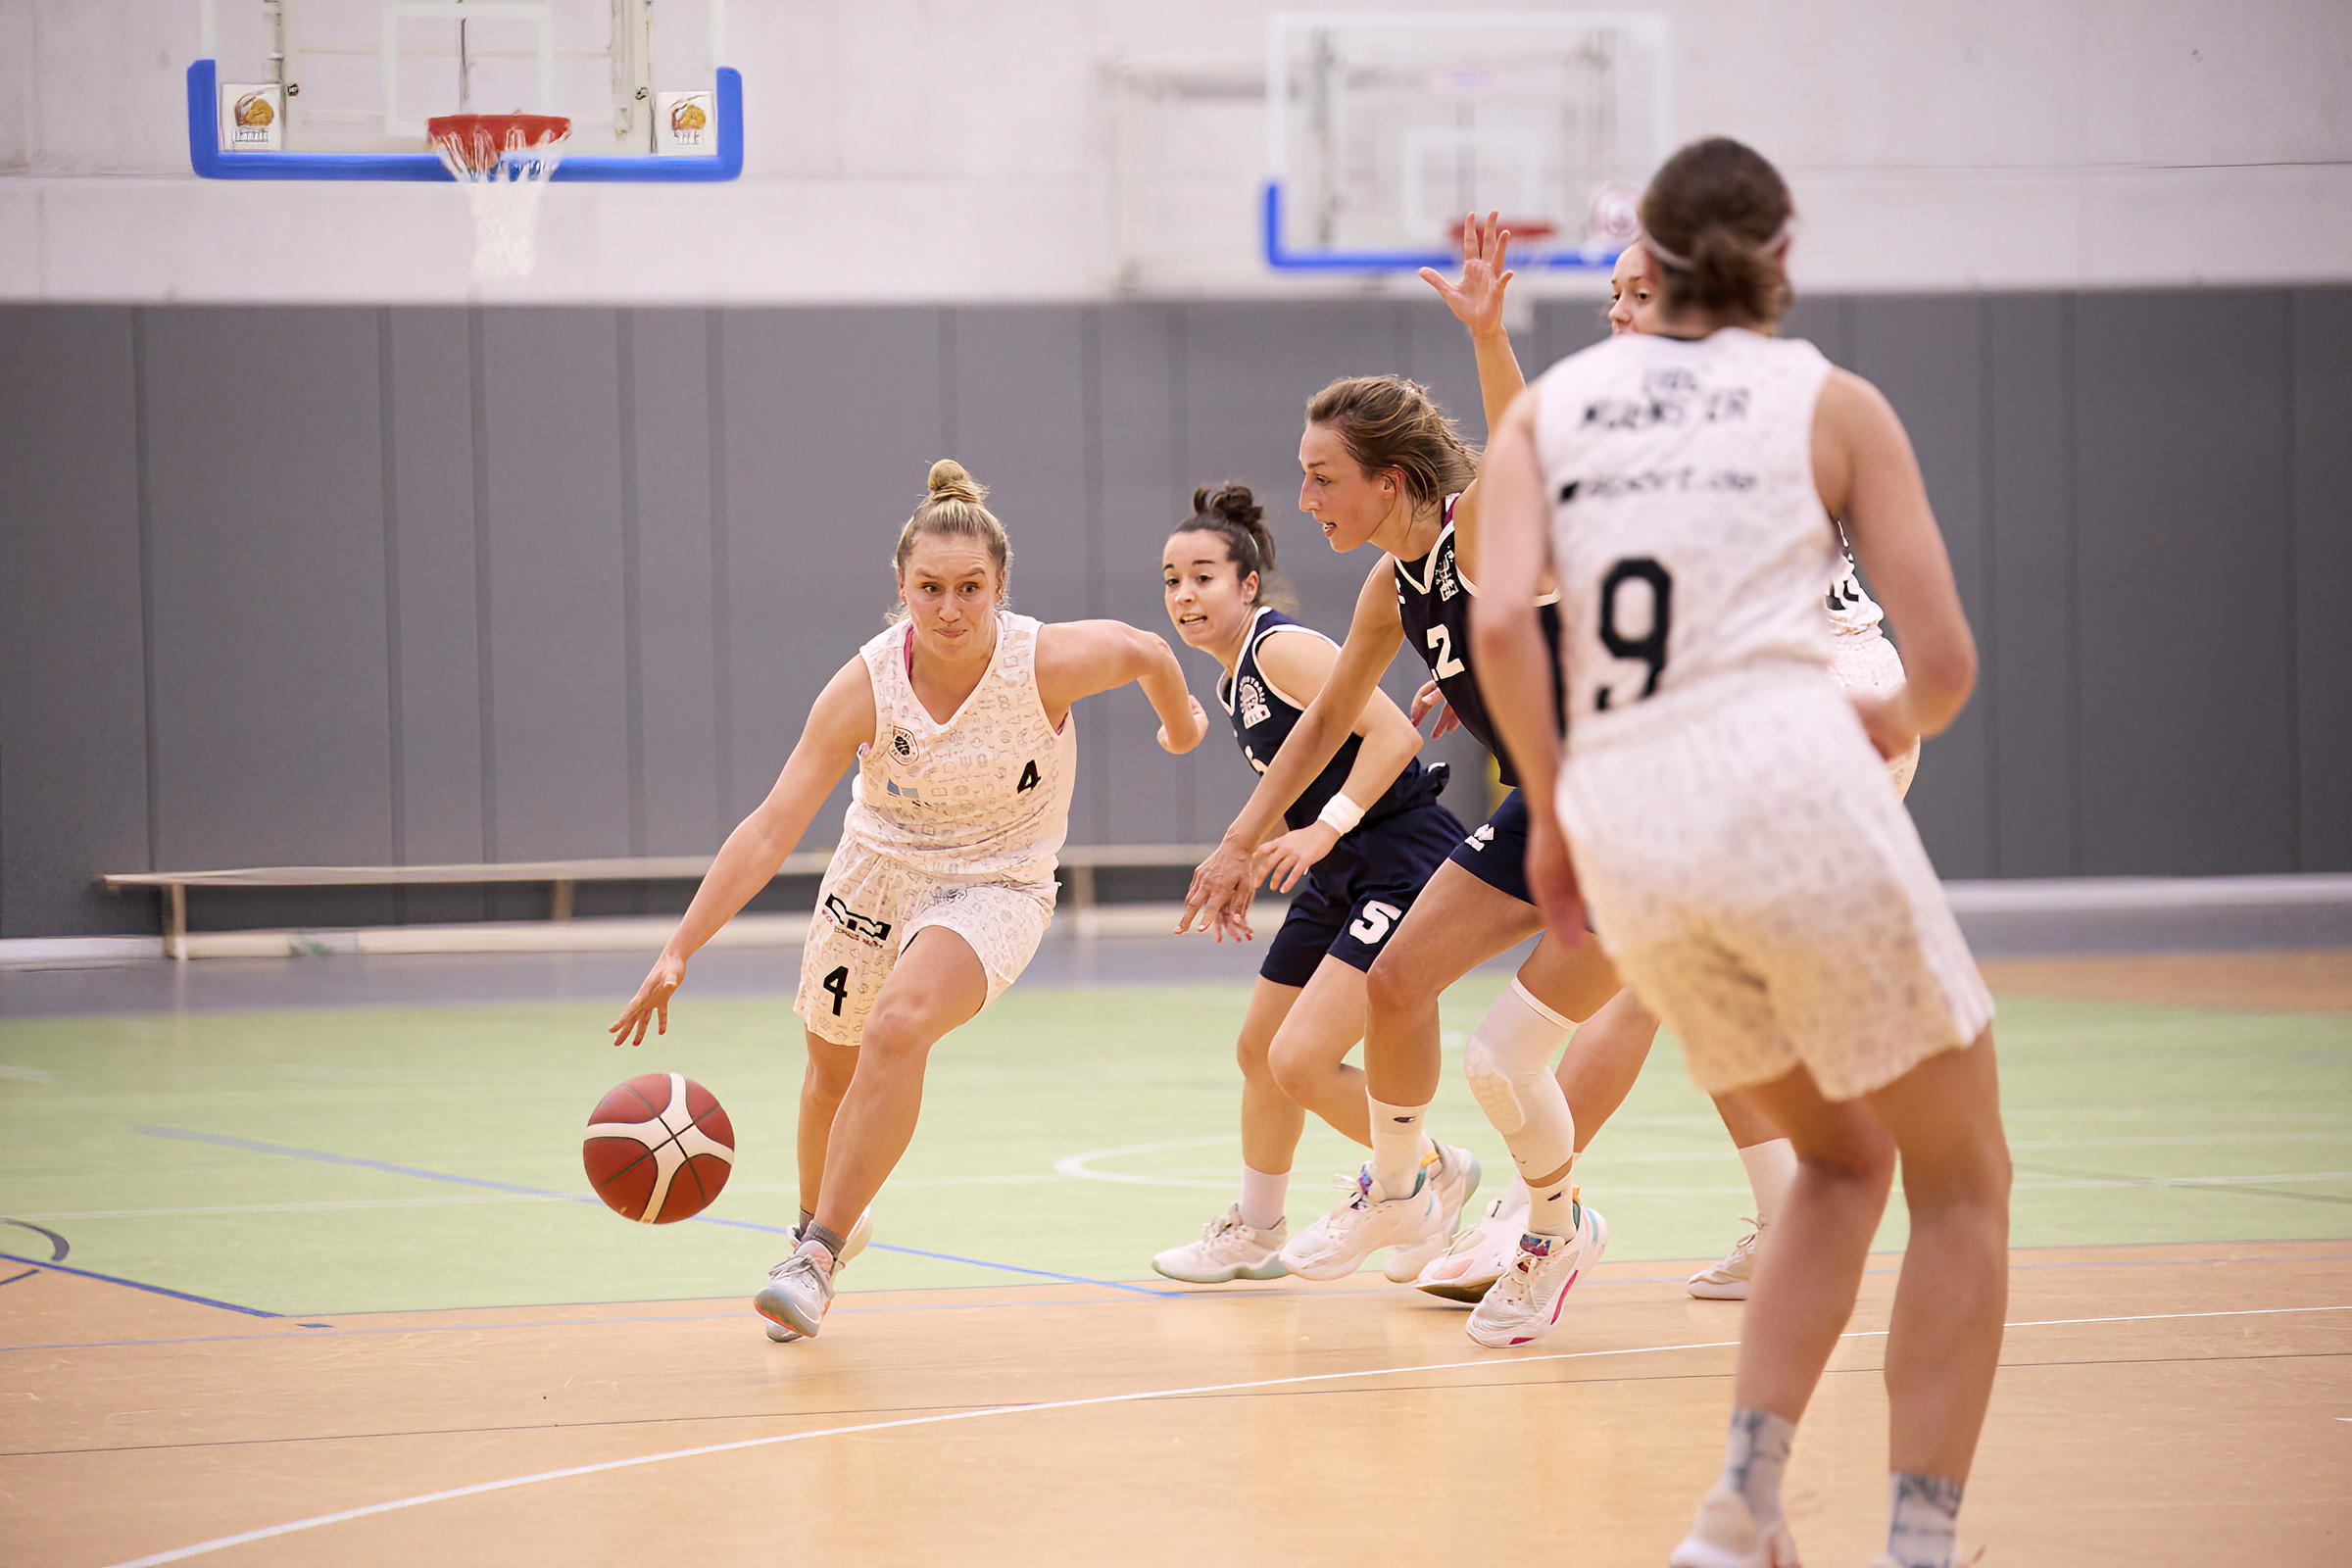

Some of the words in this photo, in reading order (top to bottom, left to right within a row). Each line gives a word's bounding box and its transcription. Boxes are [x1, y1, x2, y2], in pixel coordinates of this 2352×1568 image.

[1427, 623, 1465, 681] 2
[1595, 557, 1672, 712] 9
[1017, 760, 1042, 794] 4
[1348, 900, 1402, 945] 5
[823, 965, 849, 1017] 4
